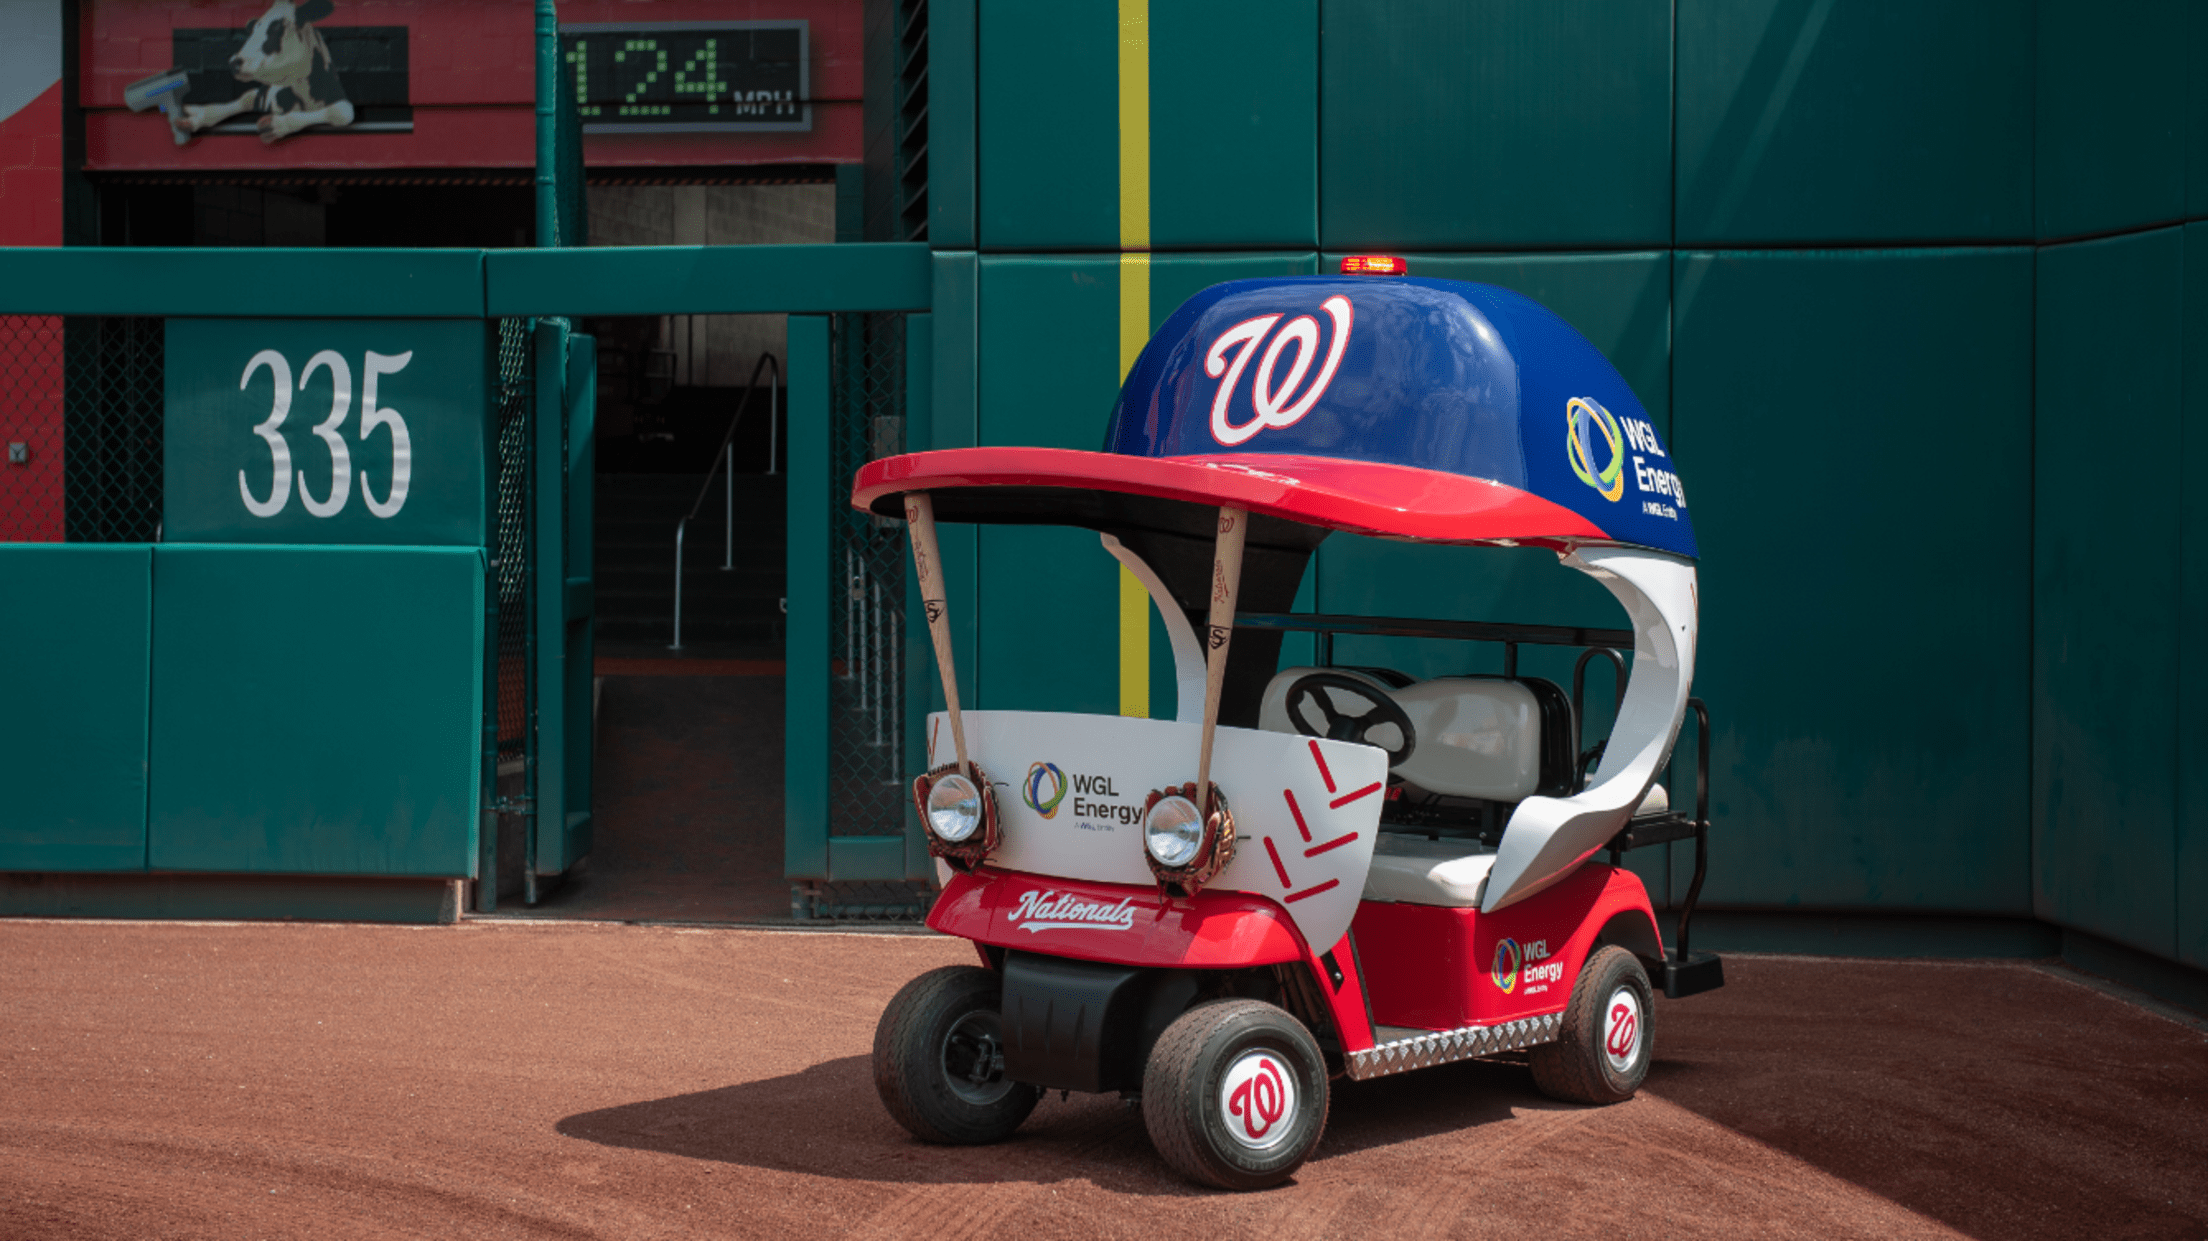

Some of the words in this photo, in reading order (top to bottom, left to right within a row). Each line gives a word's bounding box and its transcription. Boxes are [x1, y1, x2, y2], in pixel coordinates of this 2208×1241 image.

[565, 38, 728, 116] 124
[733, 90, 795, 115] MPH
[1204, 294, 1354, 448] W
[238, 348, 414, 518] 335
[1619, 415, 1665, 458] WGL
[1072, 773, 1120, 797] WGL
[1073, 796, 1143, 825] Energy
[1007, 889, 1138, 931] Nationals
[1523, 939, 1551, 962] WGL
[1523, 961, 1564, 983] Energy
[1228, 1058, 1286, 1140] W
